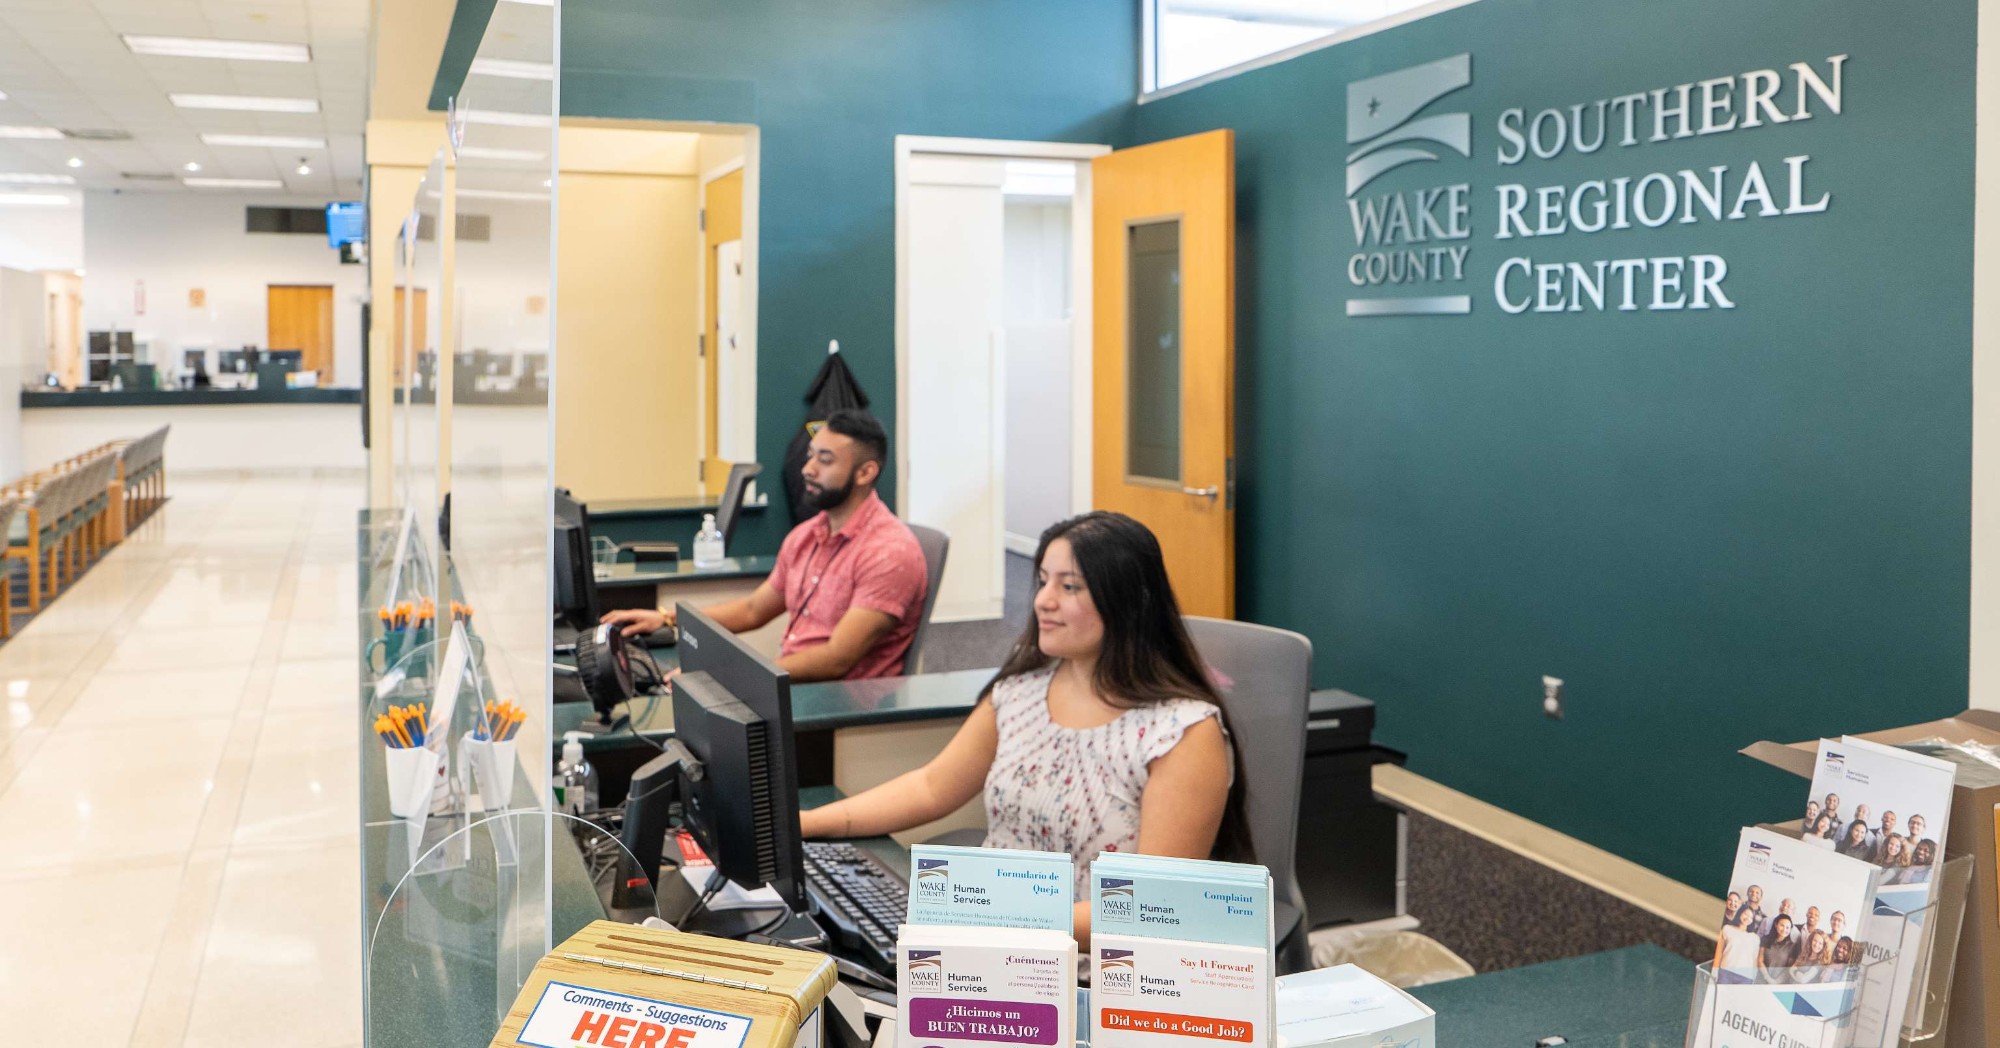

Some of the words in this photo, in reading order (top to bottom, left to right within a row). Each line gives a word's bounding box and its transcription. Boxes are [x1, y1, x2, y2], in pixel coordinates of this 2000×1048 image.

[1497, 54, 1849, 166] SOUTHERN
[1494, 155, 1831, 240] REGIONAL
[1347, 183, 1471, 247] WAKE
[1347, 246, 1469, 286] COUNTY
[1494, 254, 1735, 314] CENTER
[997, 868, 1047, 880] Formulario
[1049, 872, 1059, 881] de
[919, 881, 946, 892] WAKE
[953, 884, 986, 894] Human
[1033, 884, 1059, 895] Queja
[919, 890, 946, 898] COUNTY
[953, 894, 991, 905] Services
[1204, 891, 1253, 903] Complaint
[1103, 900, 1132, 910] WAKE
[1140, 903, 1174, 914] Human
[1227, 906, 1253, 916] Form
[1140, 914, 1180, 925] Services
[1005, 955, 1059, 966] ¡Cuéntenos!
[1180, 957, 1197, 970] Say
[1200, 959, 1209, 969] It
[1210, 960, 1254, 973] Forward!
[911, 971, 940, 981] WAKE
[948, 973, 982, 982] Human
[1103, 971, 1132, 982] WAKE
[1140, 975, 1175, 986] Human
[948, 983, 988, 993] Services
[1140, 986, 1181, 997] Services
[563, 990, 633, 1013] Comments
[645, 1005, 727, 1031] Suggestions
[946, 1005, 1001, 1019] ¿Hicimos
[1005, 1011, 1020, 1019] un
[570, 1010, 696, 1048] HERE
[928, 1021, 965, 1032] BUEN
[968, 1023, 1040, 1038] TRABAJO?
[1108, 1014, 1130, 1027] Did
[1133, 1019, 1150, 1028] we
[1153, 1018, 1168, 1030] do
[1171, 1023, 1179, 1031] a
[1182, 1021, 1213, 1035] Good
[1217, 1025, 1245, 1038] Job?
[1721, 1009, 1777, 1045] AGENCY
